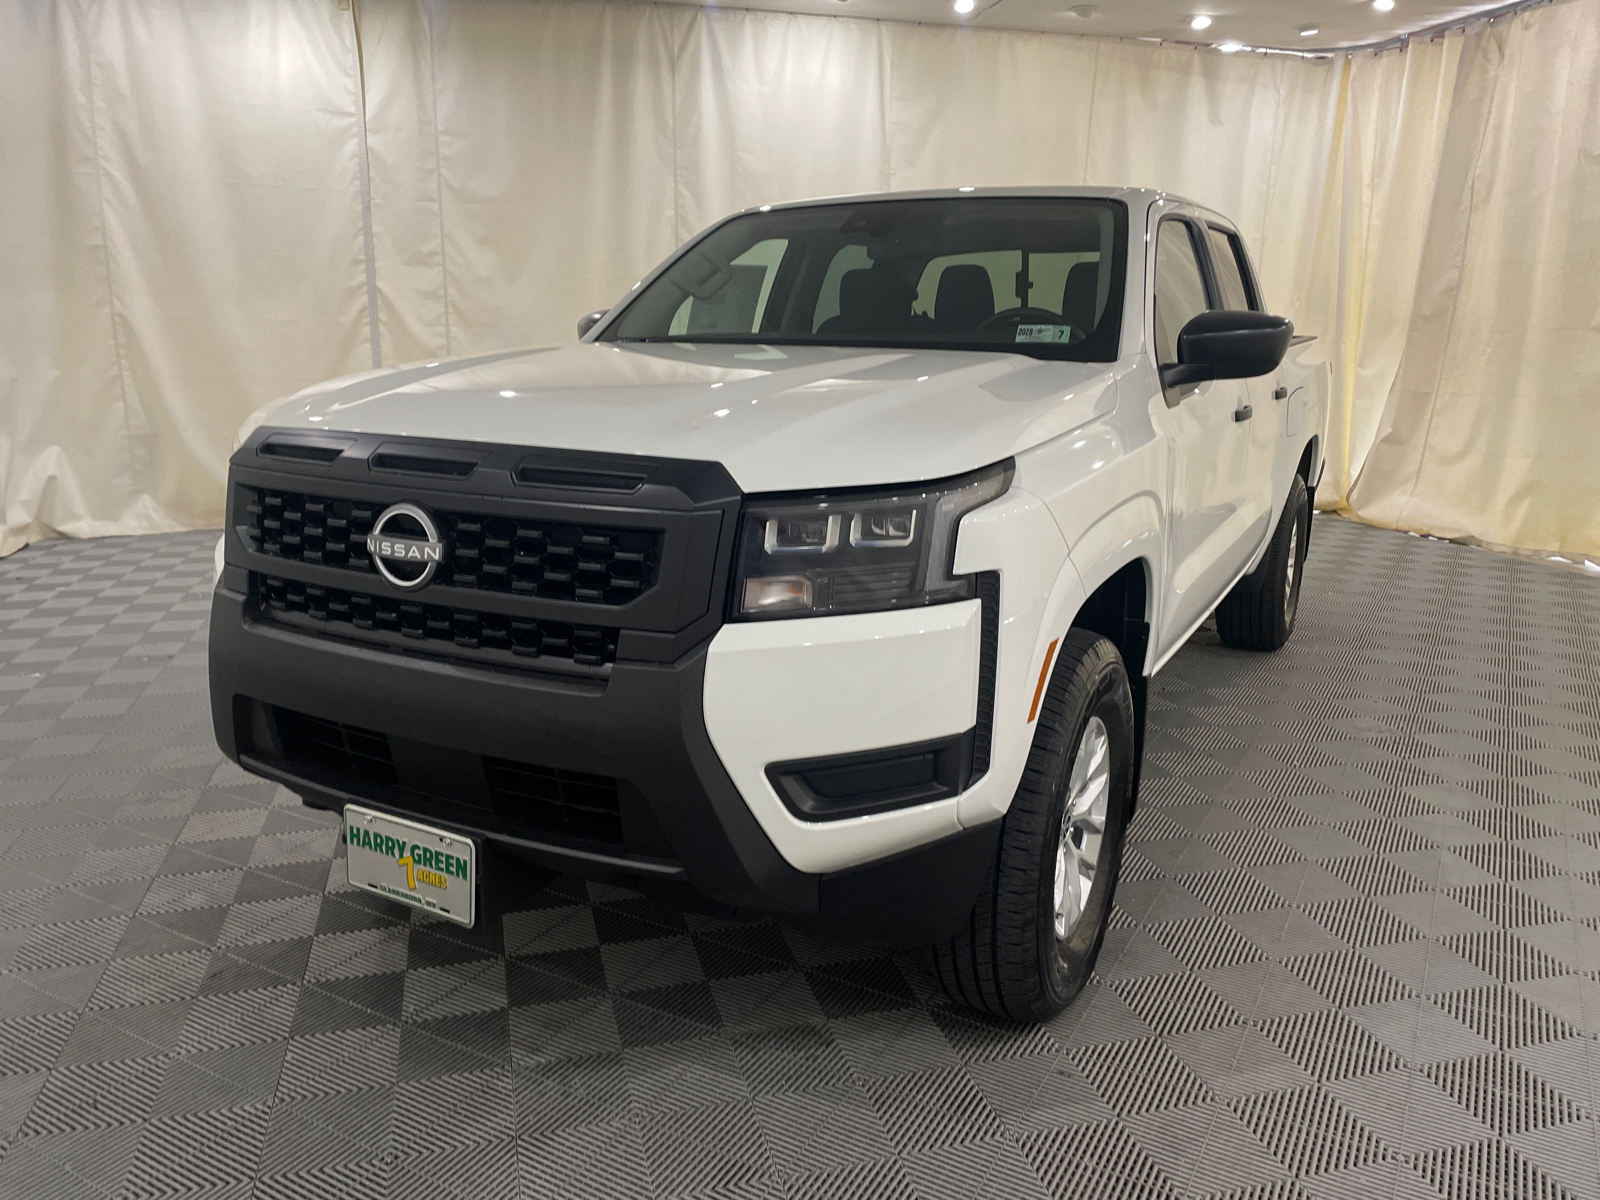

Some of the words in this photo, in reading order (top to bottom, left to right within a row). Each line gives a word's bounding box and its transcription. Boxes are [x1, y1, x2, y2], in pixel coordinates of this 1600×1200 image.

[1058, 330, 1064, 339] 7
[367, 538, 439, 560] NISSAN
[349, 825, 407, 859] HARRY
[410, 843, 468, 881] GREEN
[397, 855, 417, 890] 7
[417, 867, 448, 890] ACRES
